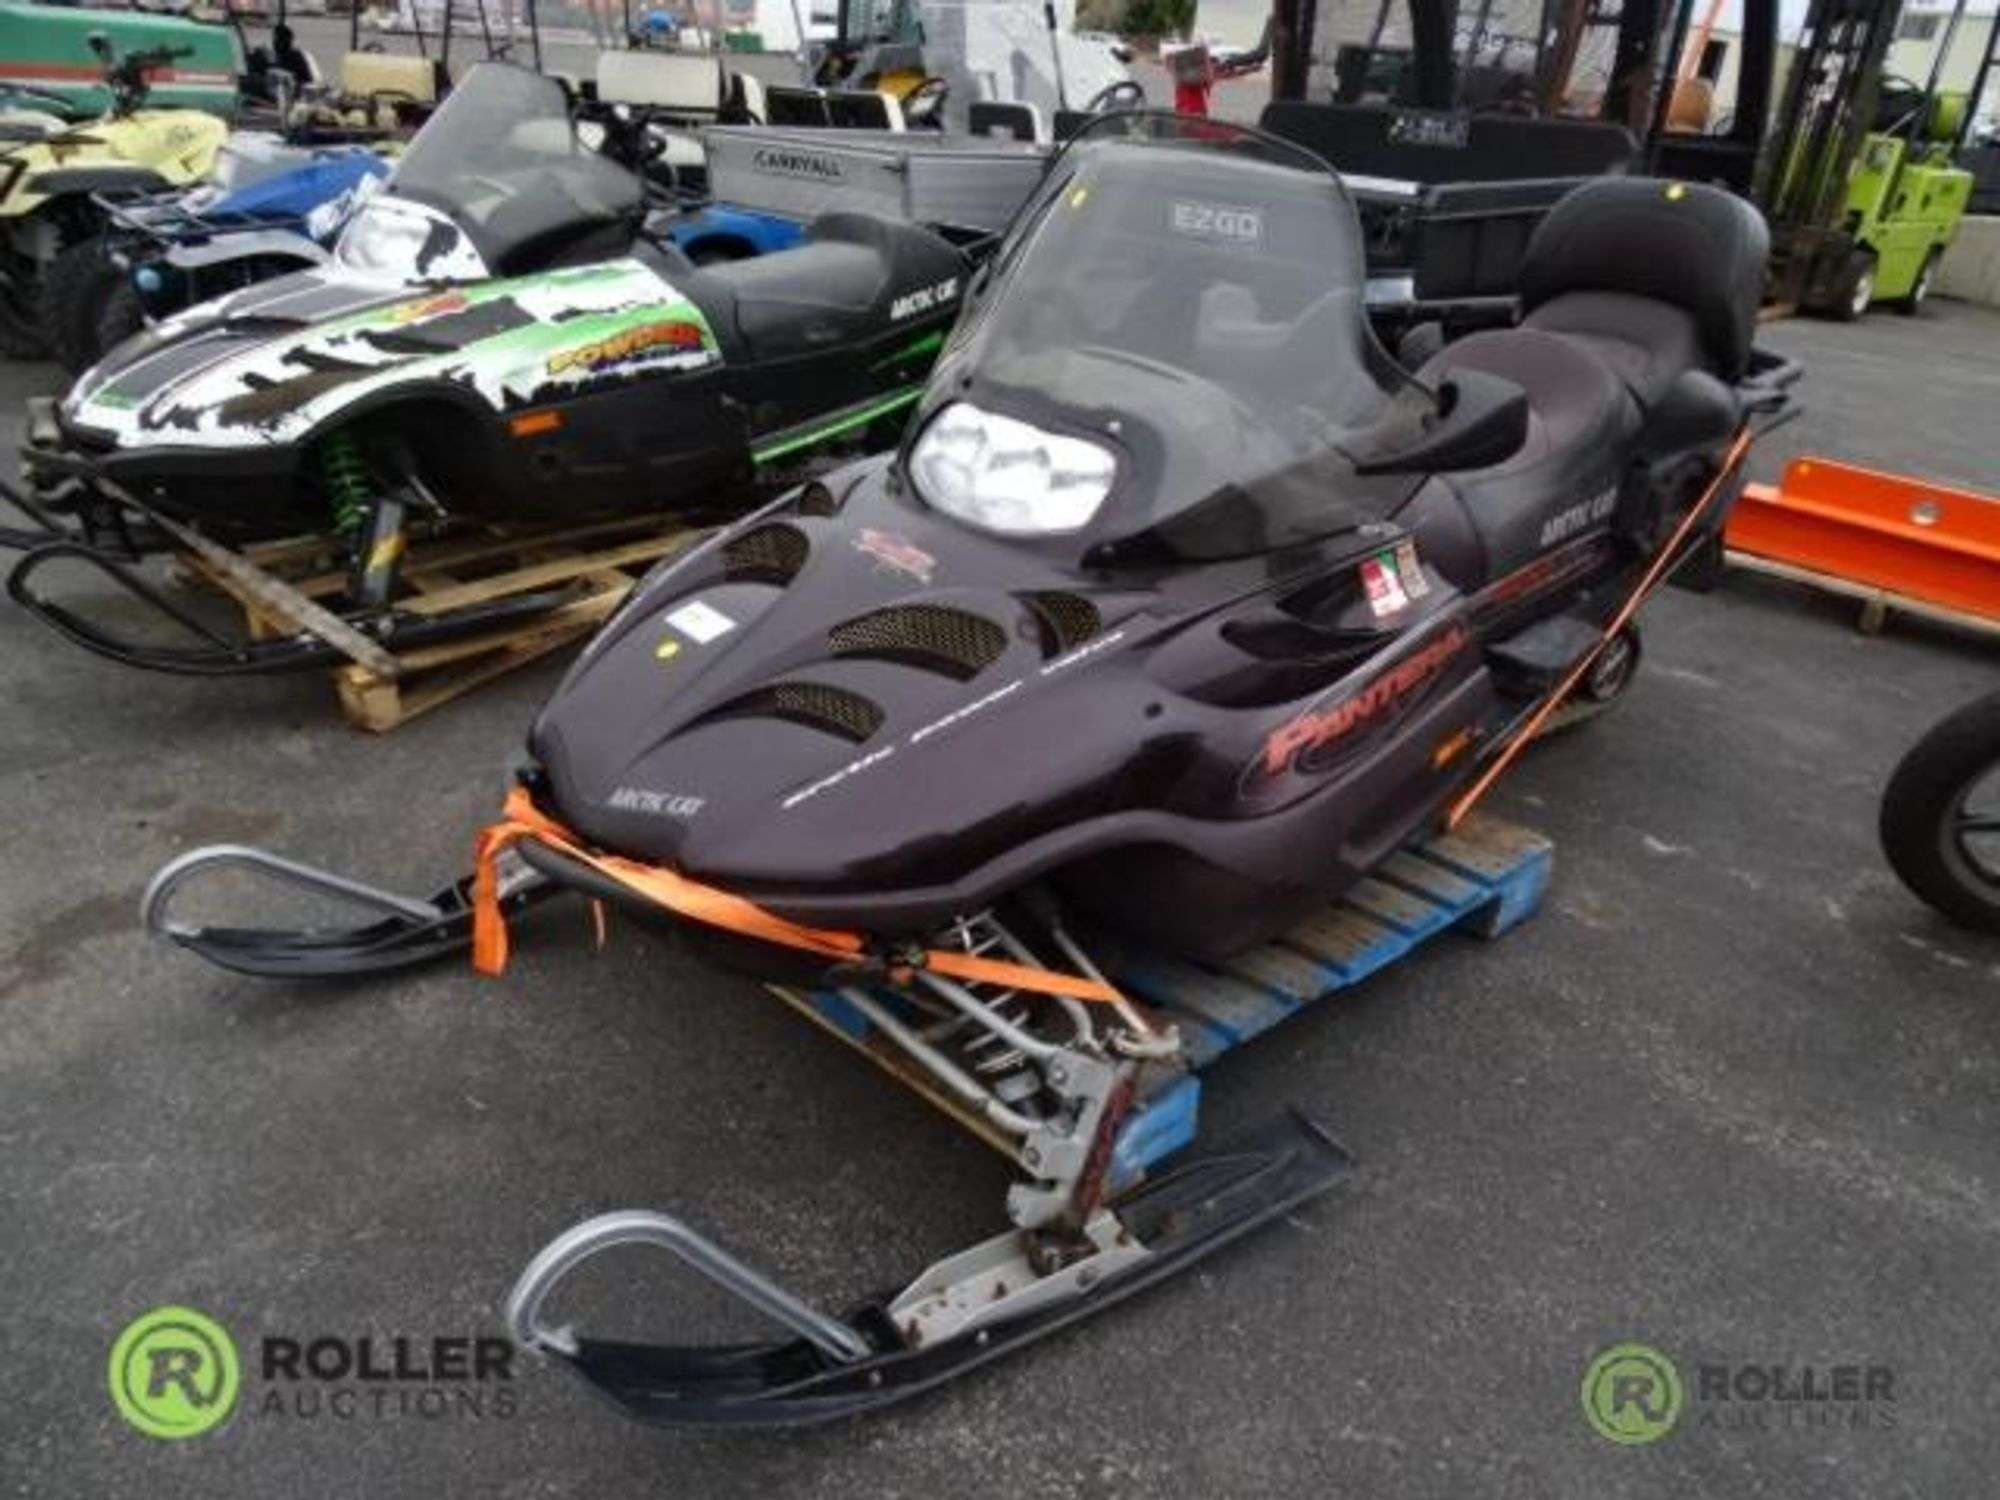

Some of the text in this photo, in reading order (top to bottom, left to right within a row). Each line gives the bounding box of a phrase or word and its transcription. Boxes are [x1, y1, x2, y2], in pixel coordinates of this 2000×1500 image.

[890, 287, 934, 320] ARCTIC
[1540, 500, 1592, 547] ARCTIC
[609, 786, 707, 817] ARCTIC CAT
